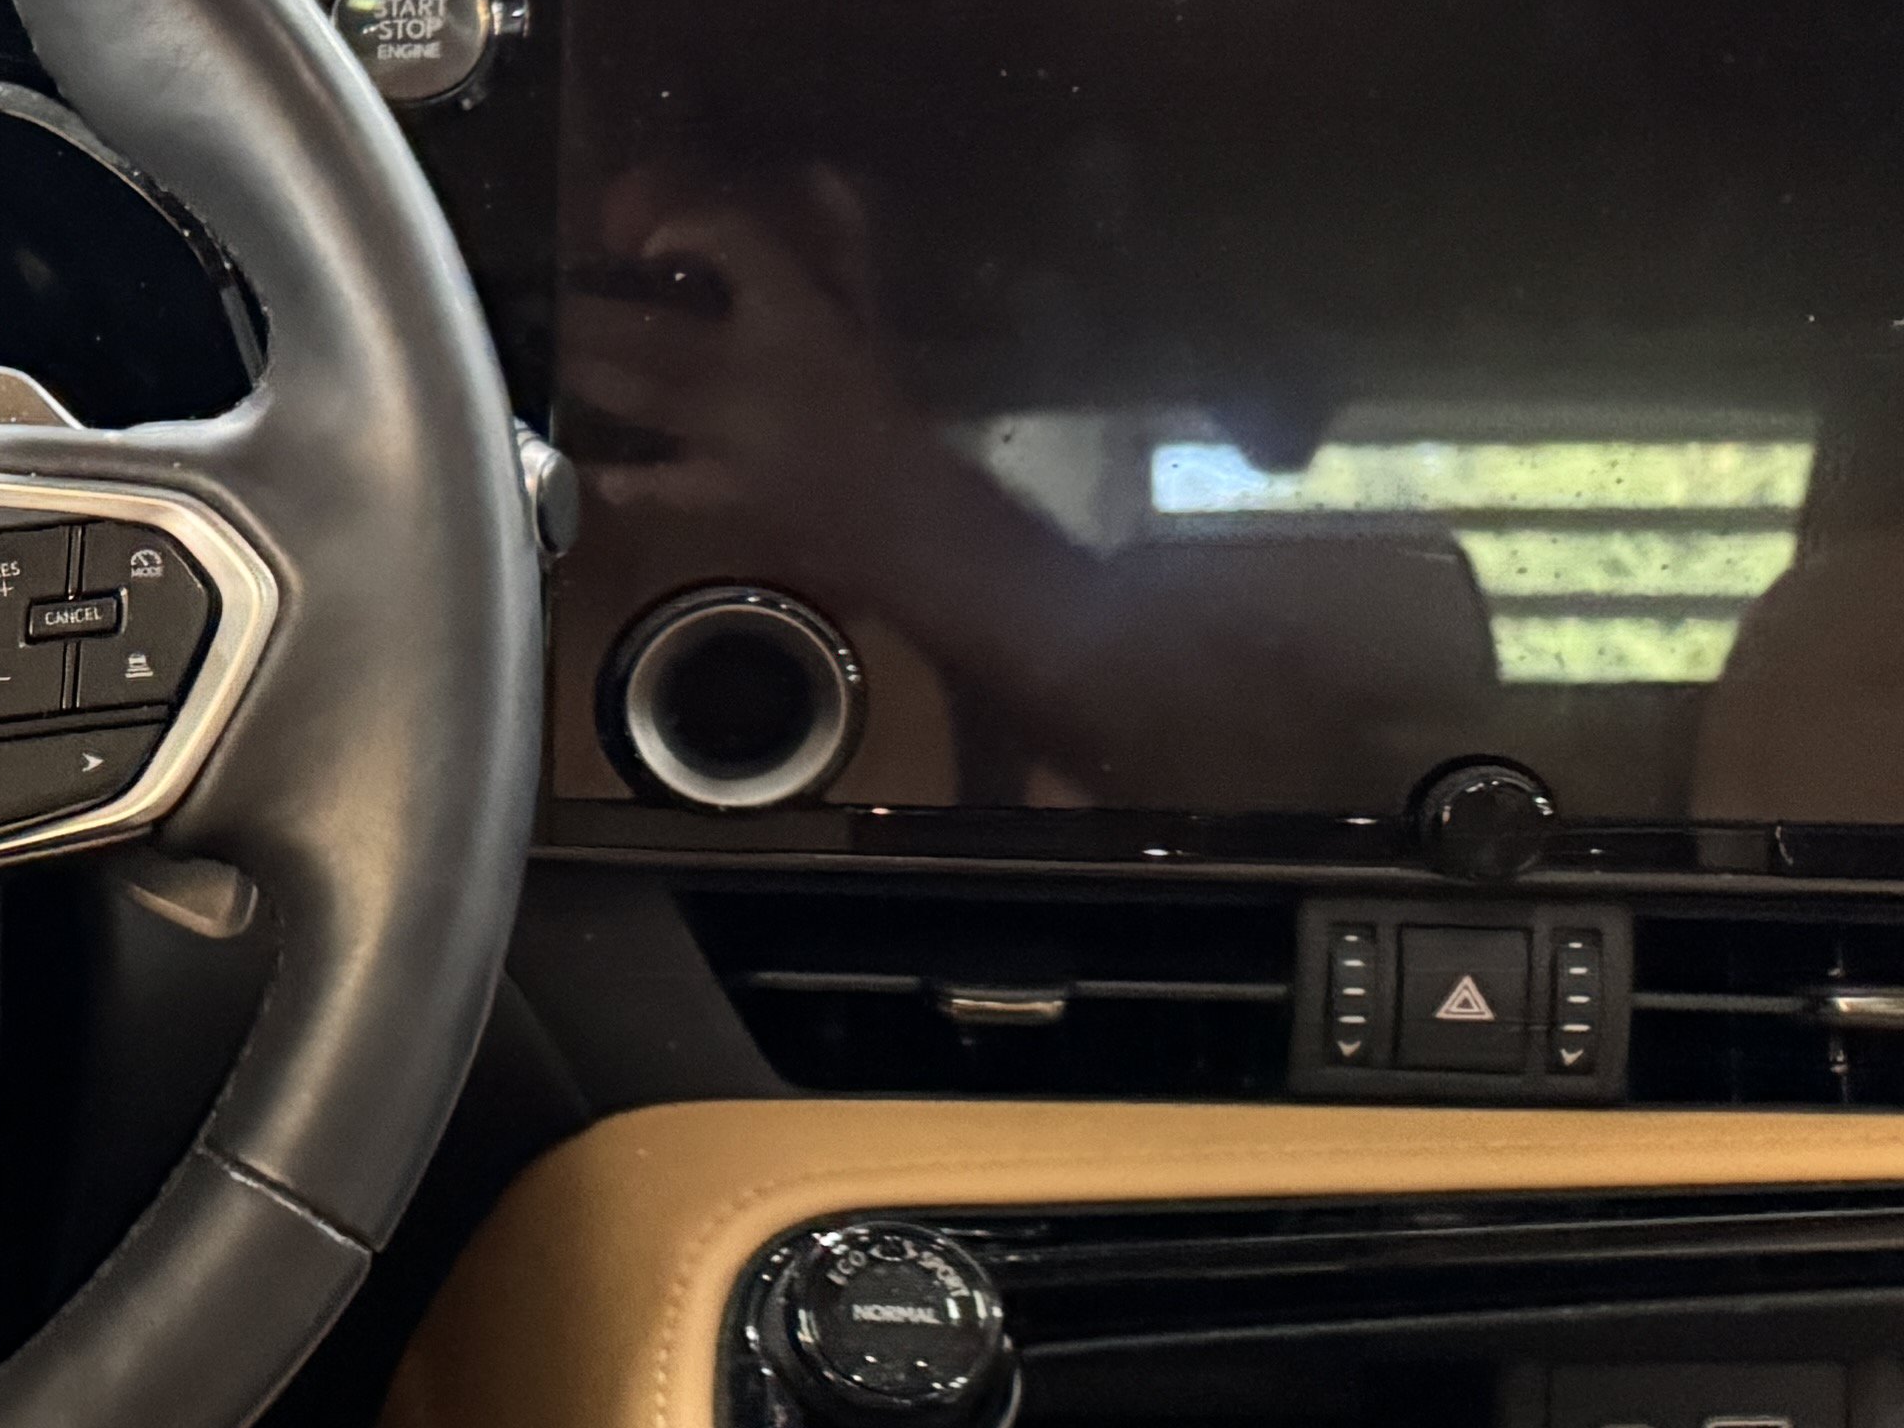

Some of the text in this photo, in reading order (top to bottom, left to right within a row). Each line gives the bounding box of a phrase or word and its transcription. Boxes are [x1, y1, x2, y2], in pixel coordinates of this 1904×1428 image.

[377, 20, 444, 40] STOP
[377, 42, 441, 60] ENGINE
[44, 606, 104, 627] CANCEL
